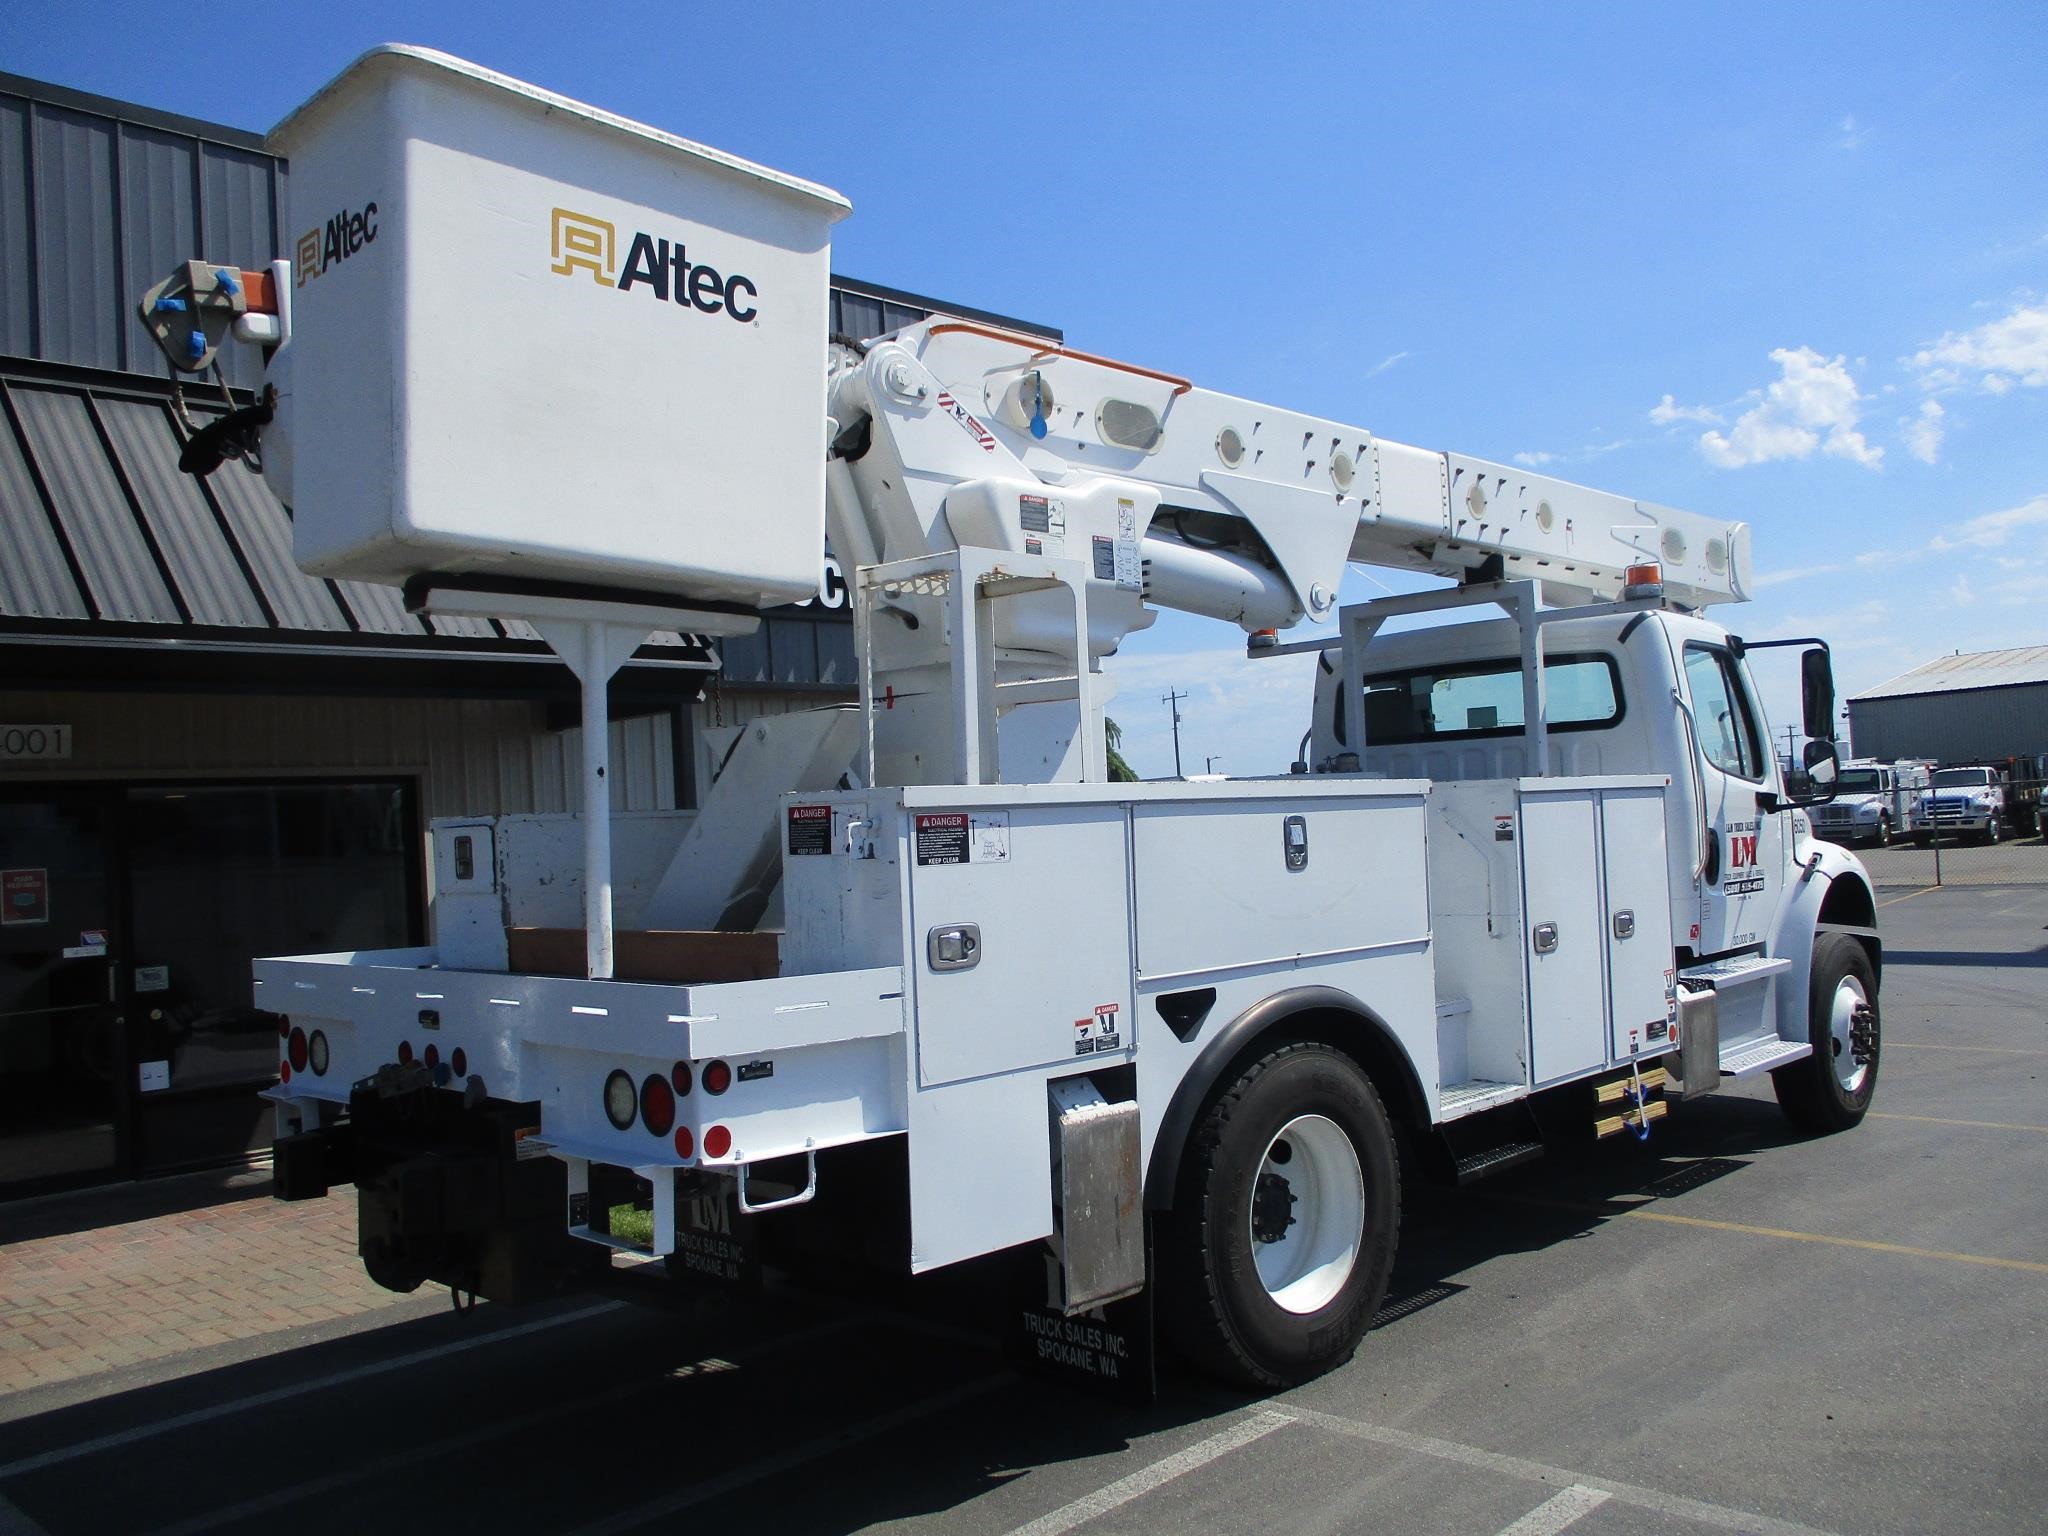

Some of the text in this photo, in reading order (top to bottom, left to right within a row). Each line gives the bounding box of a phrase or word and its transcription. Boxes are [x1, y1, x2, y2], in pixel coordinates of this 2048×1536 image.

[322, 202, 378, 274] Altec
[617, 231, 758, 323] Altec
[0, 729, 61, 754] 001
[800, 808, 826, 818] DANGER
[931, 816, 962, 827] DANGER
[928, 856, 960, 865] KEEP CLEAR
[677, 1231, 702, 1250] TRUCK
[704, 1238, 728, 1258] SALES
[1023, 1312, 1129, 1358] TRUCK SALES INC.
[1037, 1338, 1118, 1379] SPOKANE, WA
